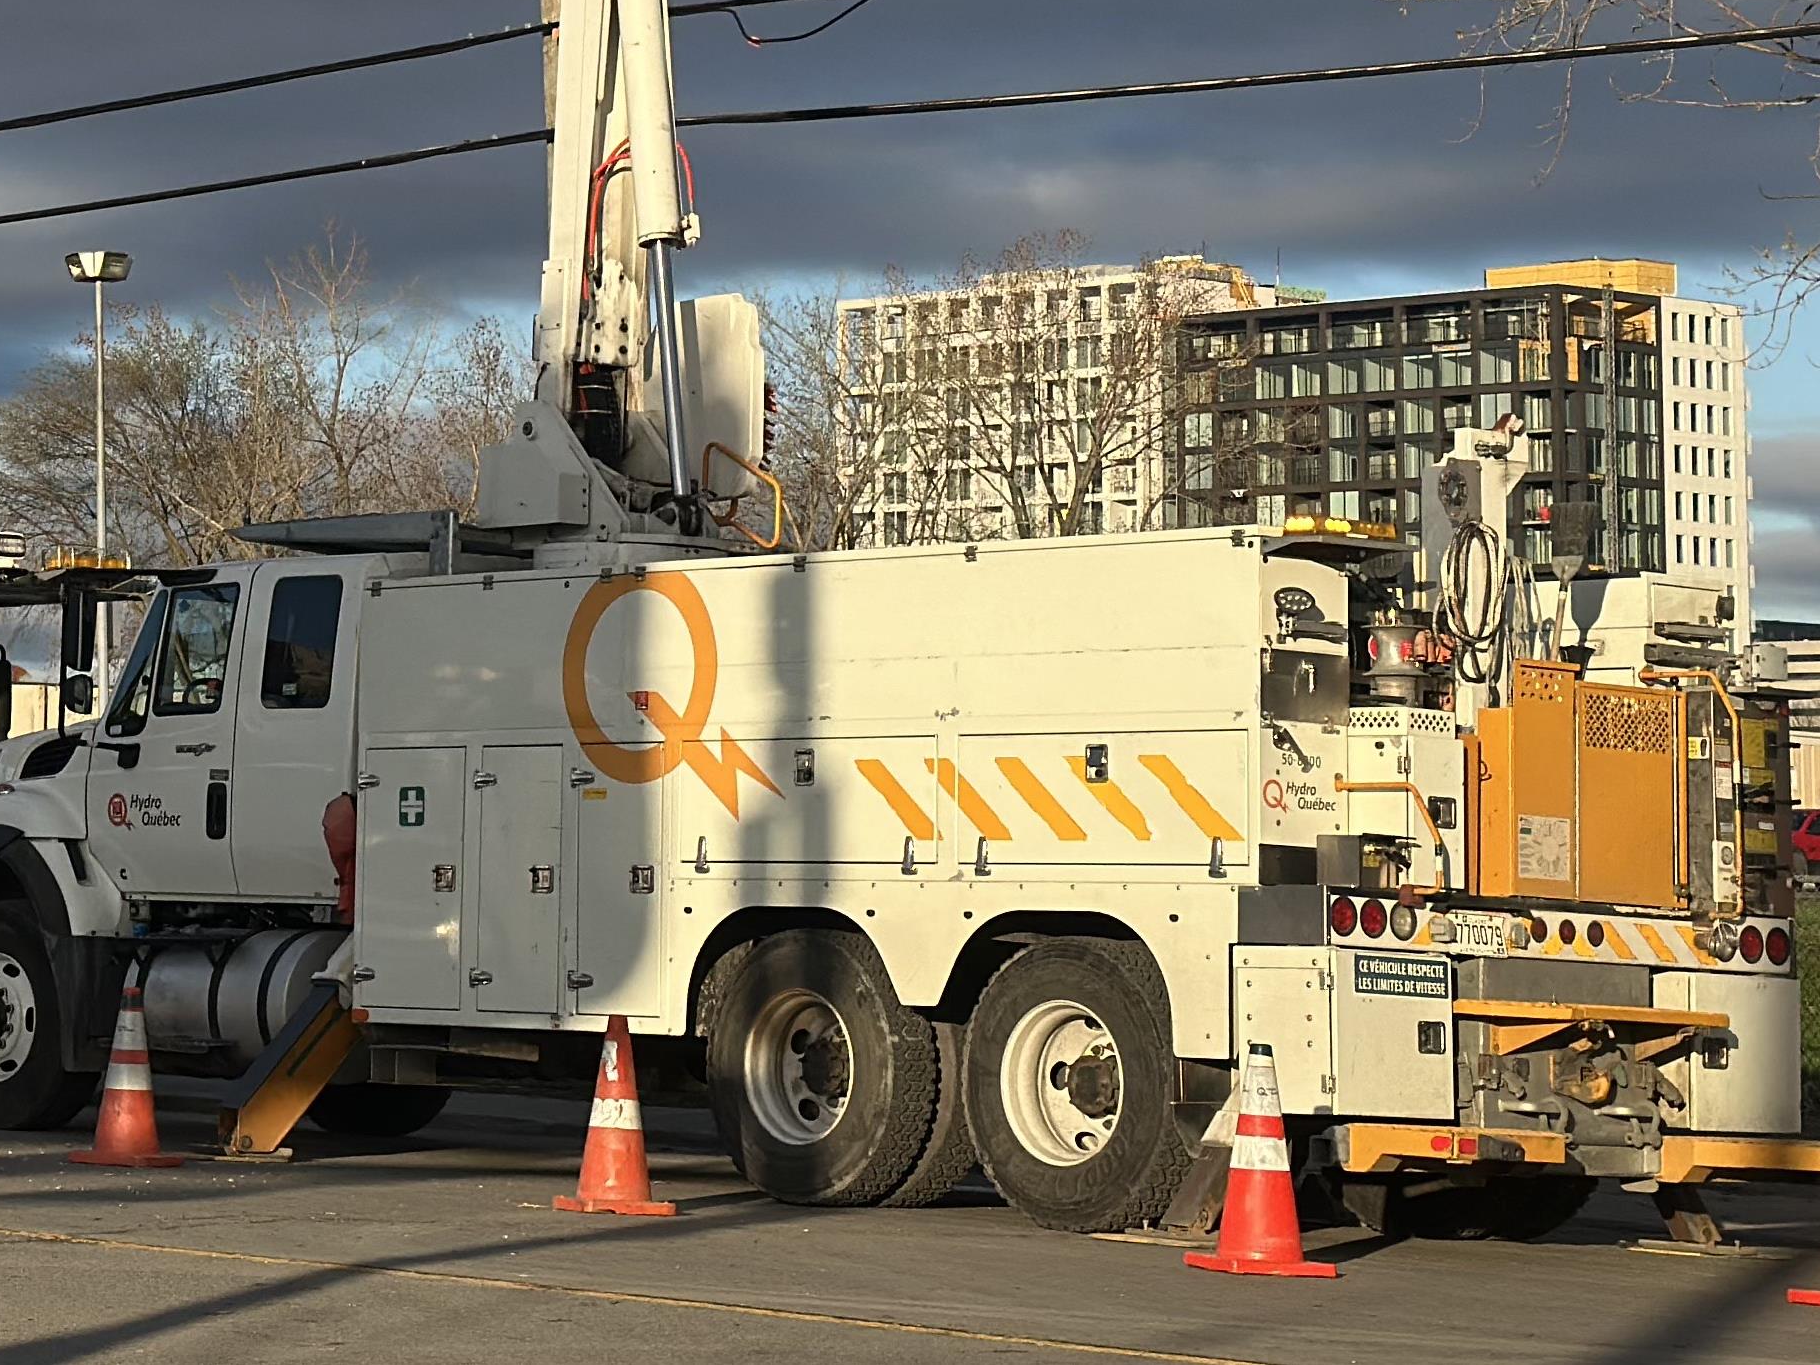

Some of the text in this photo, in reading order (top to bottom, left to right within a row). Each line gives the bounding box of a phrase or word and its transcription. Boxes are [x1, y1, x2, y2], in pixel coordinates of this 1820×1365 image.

[1286, 781, 1317, 797] Hydro
[130, 793, 162, 812] Hydro
[1297, 796, 1337, 812] Québec
[141, 810, 181, 827] Québec
[1359, 958, 1445, 979] CE VÉHICULE RESPECTE
[1358, 977, 1447, 995] LES LIMITES DE VITESSE
